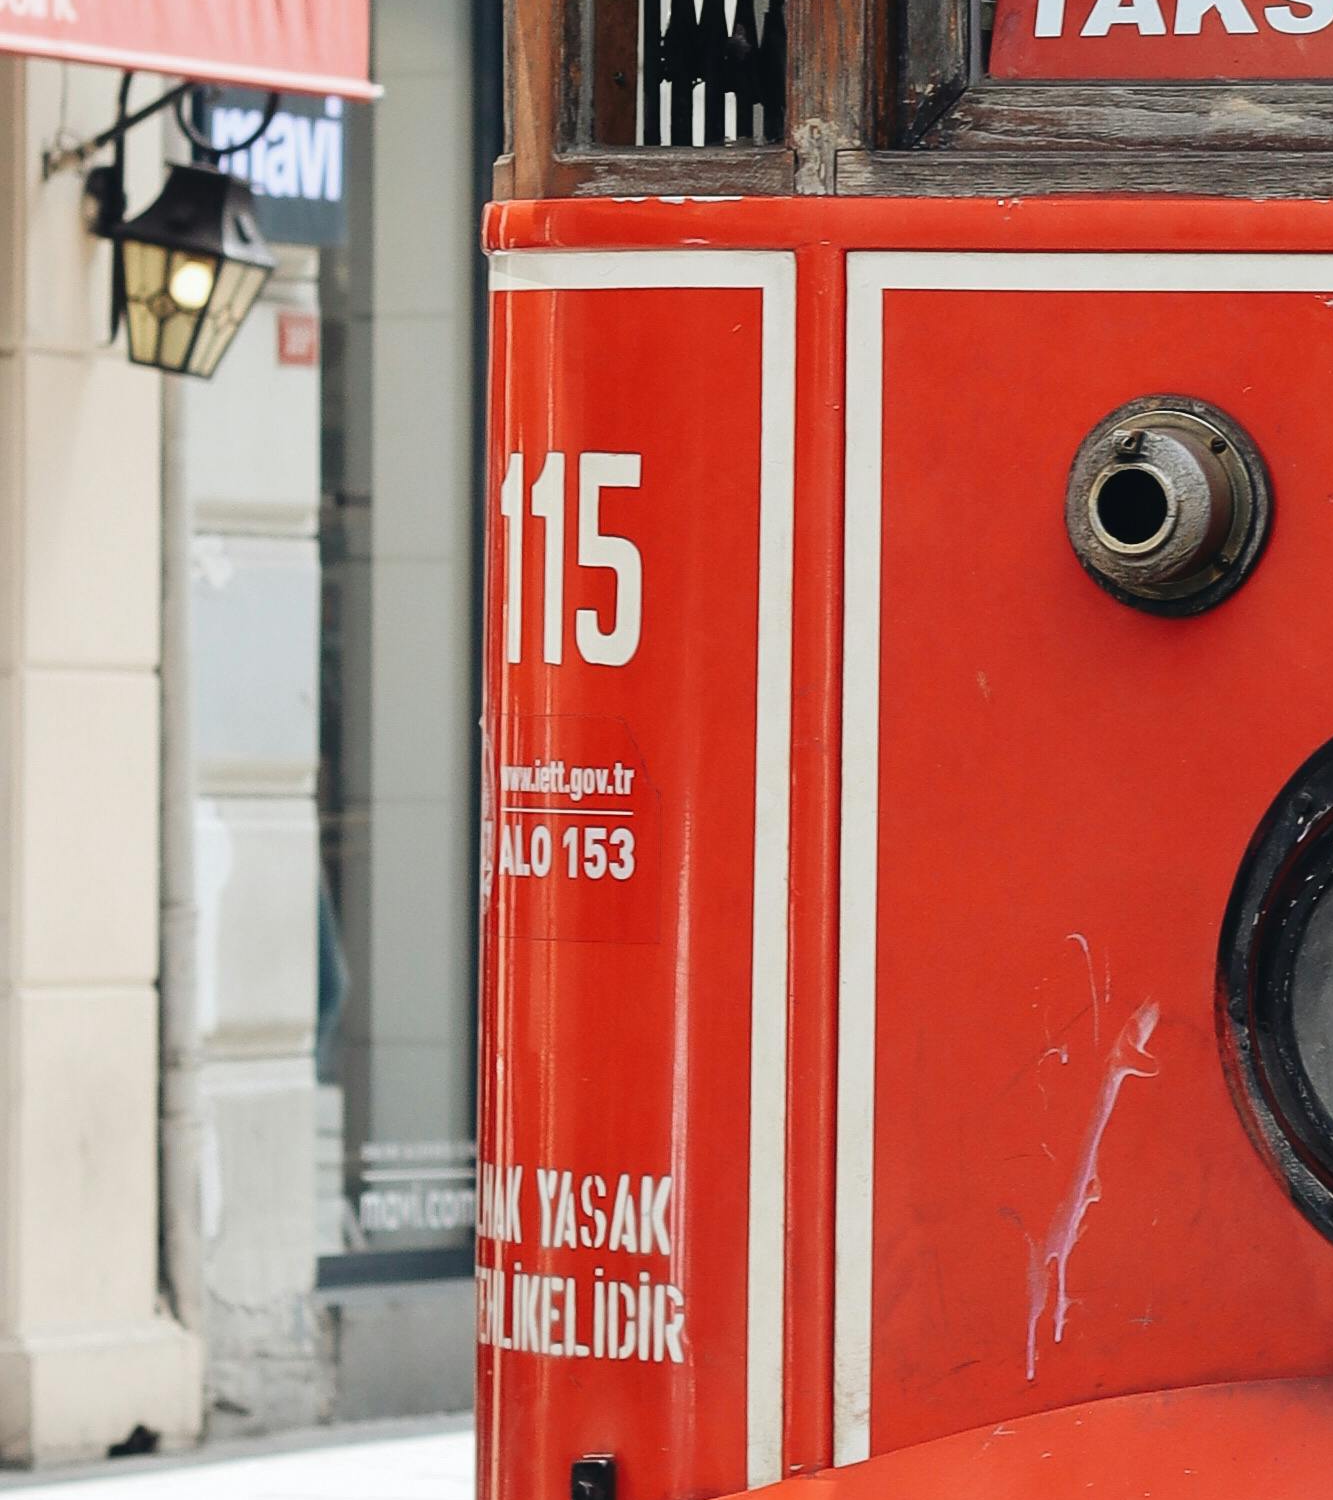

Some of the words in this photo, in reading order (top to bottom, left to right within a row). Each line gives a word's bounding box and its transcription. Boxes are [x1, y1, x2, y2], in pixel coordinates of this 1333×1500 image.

[212, 96, 343, 201] mavi
[501, 452, 643, 667] 115
[499, 824, 551, 877] ALO
[563, 827, 635, 880] 153
[536, 1168, 673, 1256] YASAK
